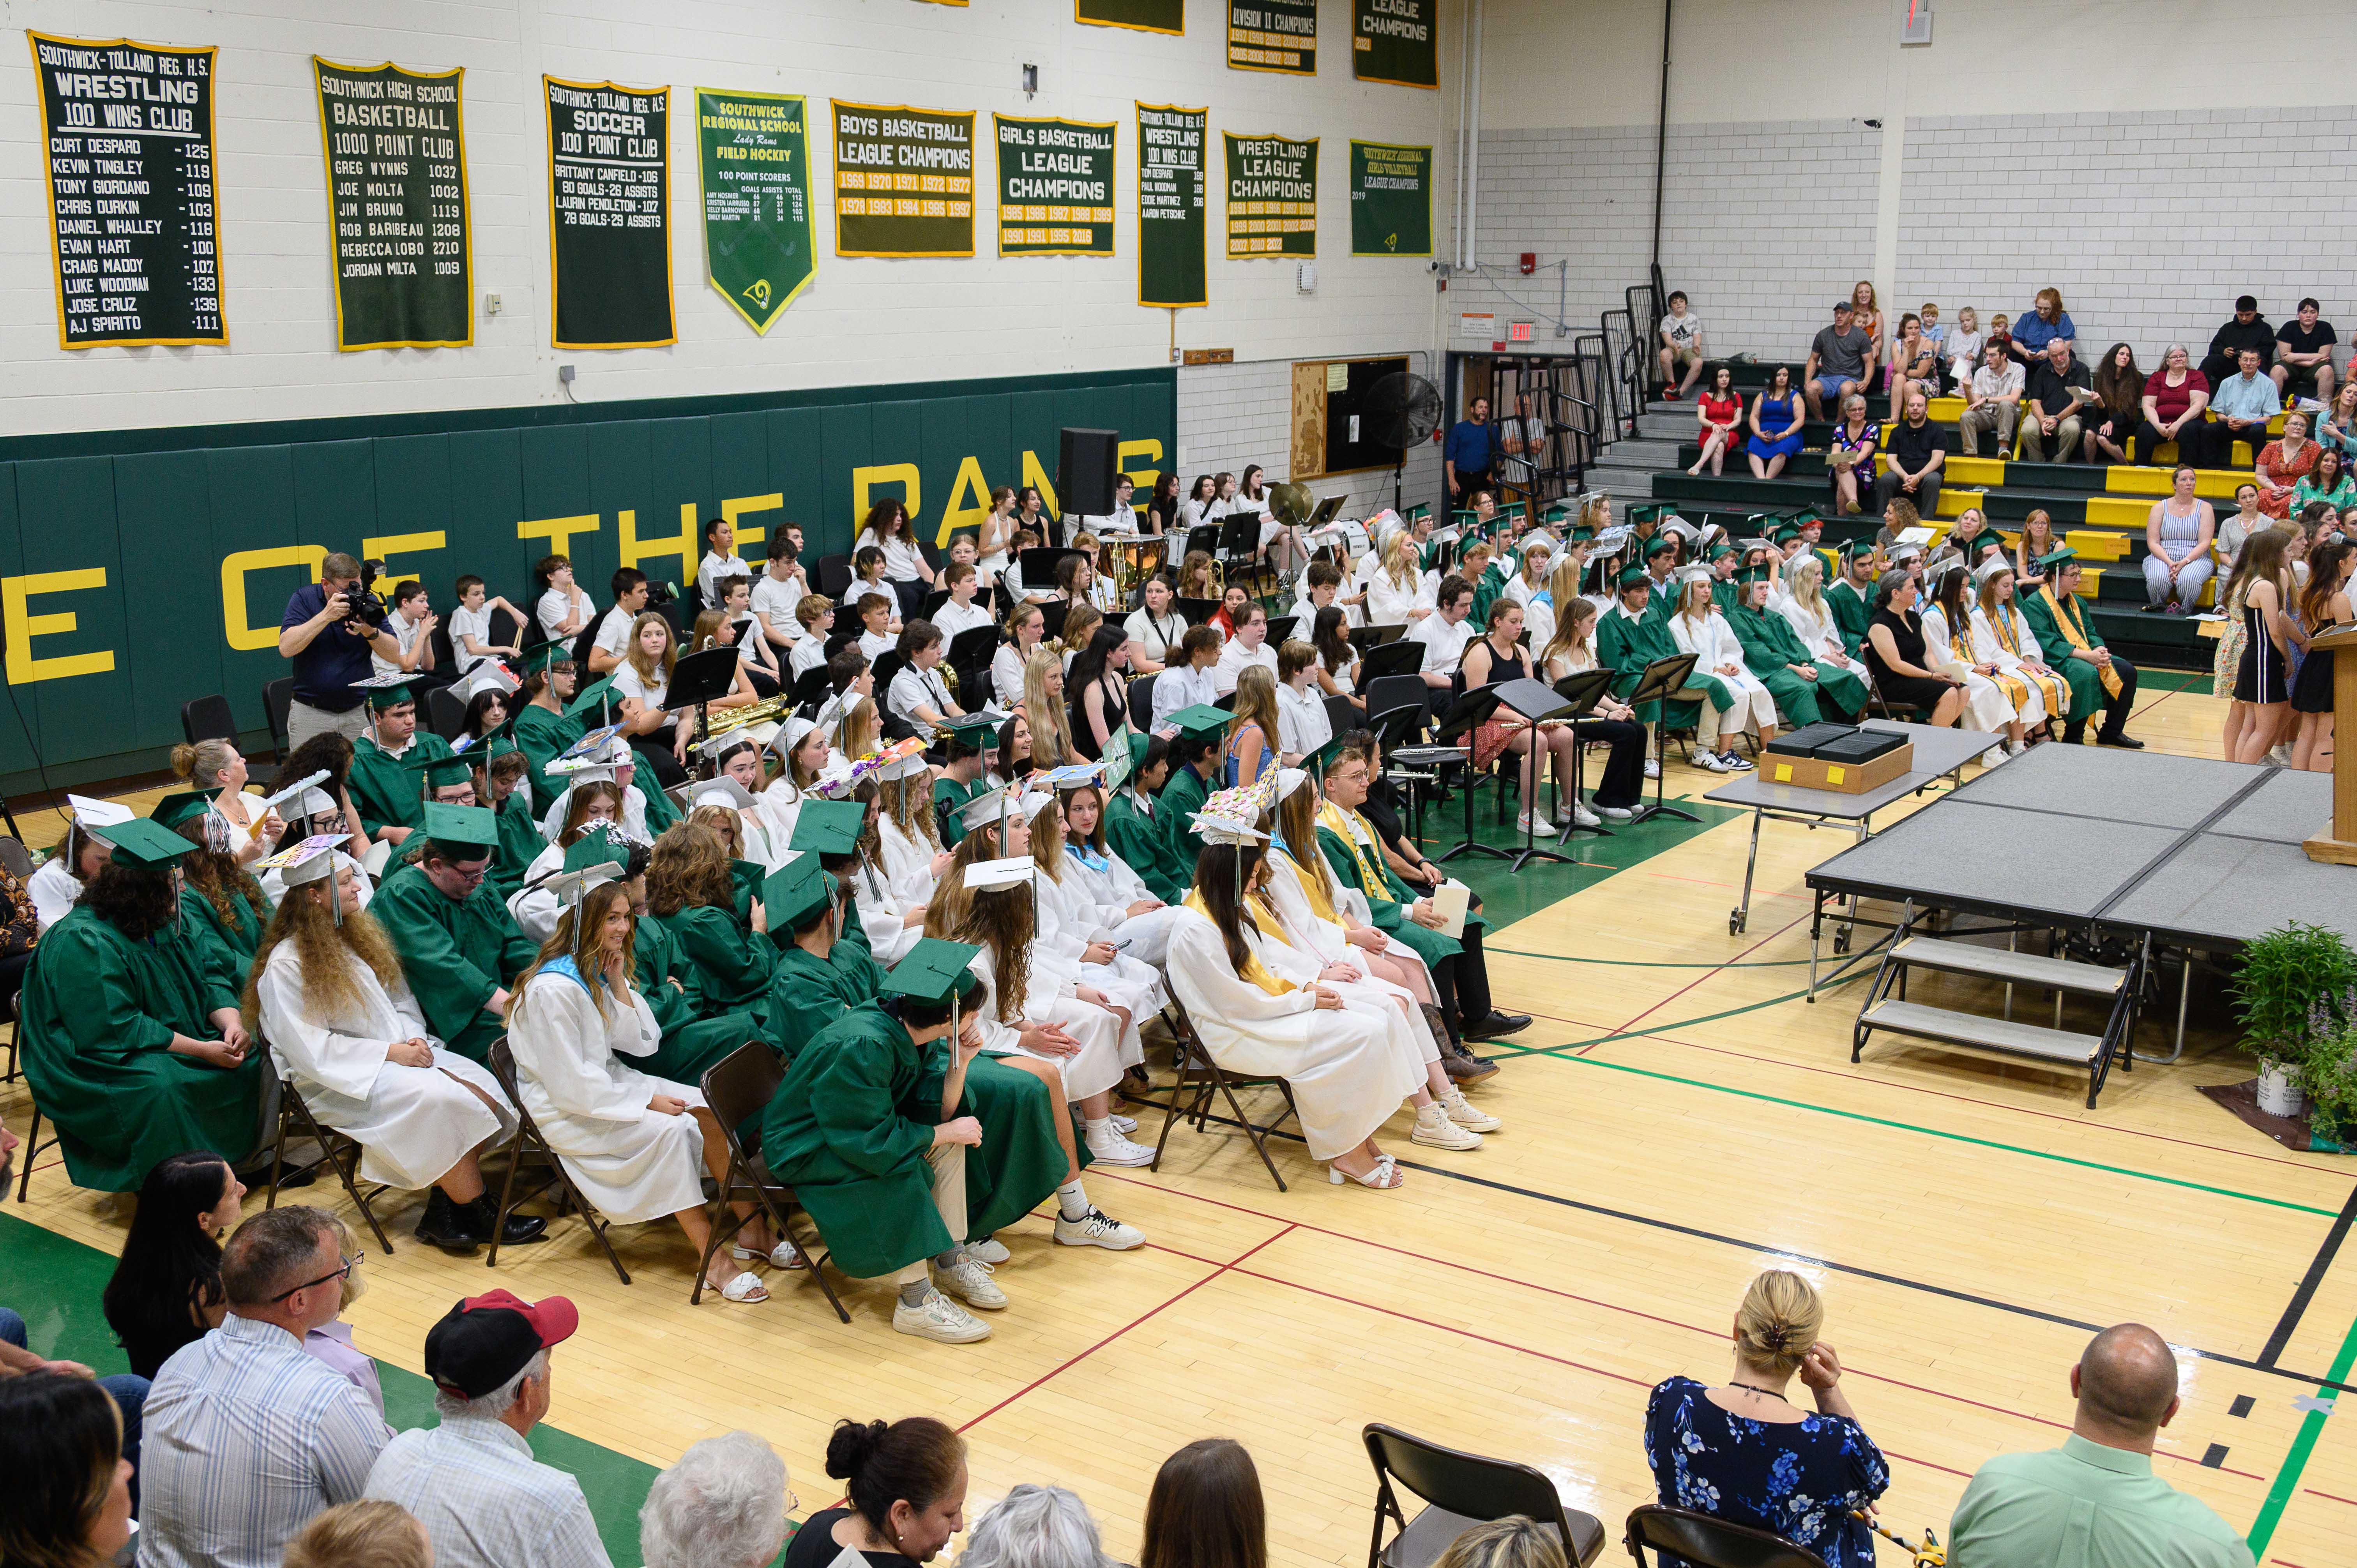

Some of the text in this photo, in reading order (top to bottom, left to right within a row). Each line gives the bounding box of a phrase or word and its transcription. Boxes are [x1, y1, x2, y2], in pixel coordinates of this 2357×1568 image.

[1373, 0, 1419, 18] LEAGUE
[1233, 7, 1261, 27] DIVISION
[1275, 14, 1313, 34] CHAMPIONS
[1362, 15, 1427, 41] CHAMPIONS
[1356, 38, 1370, 50] 2021
[39, 44, 208, 76] SOUTHWICK-TOLLAND REG. H.S.
[55, 72, 198, 104] WRESTLING
[322, 76, 456, 102] SOUTHWICK HIGH SCHOOL
[550, 86, 665, 113] SOUTHWICK-TOLLAND REG. H.S.
[65, 102, 192, 131] 100 WINS CLUB
[334, 103, 449, 131] BASKETBALL
[720, 102, 786, 118] SOUTHWICK
[574, 110, 645, 135] SOCCER
[703, 116, 801, 133] REGIONAL SCHOOL
[841, 115, 967, 141] BOYS BASKETBALL
[562, 132, 657, 157] 100 POINT CLUB
[733, 133, 776, 146] Lady Rams
[1000, 126, 1111, 149] GIRLS BASKETBALL
[1146, 128, 1199, 146] WRESTLING
[51, 138, 140, 154] CURT DESPARD
[335, 133, 453, 159] 1000 POINT CLUB
[717, 147, 791, 161] FIELD HOCKEY
[1238, 141, 1307, 158] WRESTLING
[839, 141, 970, 169] LEAGUE CHAMPIONS
[1022, 152, 1092, 174] LEAGUE
[1148, 147, 1197, 164] 100 WINS CLUB
[53, 159, 143, 175] KEVIN TINGLEY
[335, 161, 456, 178] GREG WYNNS 1037
[555, 164, 594, 179] BRITTANY
[597, 168, 636, 182] CANFIELD
[1141, 168, 1151, 178] TOM
[1244, 159, 1301, 178] LEAGUE
[719, 171, 790, 182] 100 POINT SCORERS
[840, 173, 970, 193] 1969 1970 1971 1972 1977
[1365, 176, 1418, 189] LEAGUE CHAMPIONS
[55, 179, 150, 194] TONY GIORDANO
[338, 183, 458, 198] JOE MOLTA 1002
[563, 181, 657, 198] 80 ASSISTS
[1009, 178, 1104, 200] CHAMPIONS
[1232, 180, 1311, 198] CHAMPIONS
[57, 200, 140, 214] CHRIS DURKIN
[556, 196, 636, 212] LAURIN PENDLETON
[841, 200, 970, 216] 1978 1983 1984 1997
[1157, 196, 1180, 205] MARTINEZ
[339, 203, 459, 217] JIM BRUNO 1119
[1002, 206, 1046, 220] 1985 1986
[58, 220, 162, 234] DANIEL WHALLEY
[565, 212, 660, 227] 78 ASSISTS
[340, 222, 460, 236] ROB BARIBEAU 1208
[1004, 230, 1091, 242] 1990 1991 1995 2016
[60, 240, 131, 254] EVAN HART
[341, 242, 459, 257] REBECCA LOBO 2710
[62, 259, 143, 274] CRAIG MADDY
[343, 262, 459, 277] JORDAN MOLTA 1009
[65, 279, 94, 293] LUKE
[99, 277, 148, 292] WOODMAN
[68, 298, 99, 313] JOSE
[102, 297, 137, 311] CRUZ
[71, 318, 87, 334] AJ
[92, 316, 141, 332] SPIRITO
[1512, 324, 1530, 340] EXIT
[518, 493, 782, 586] THE
